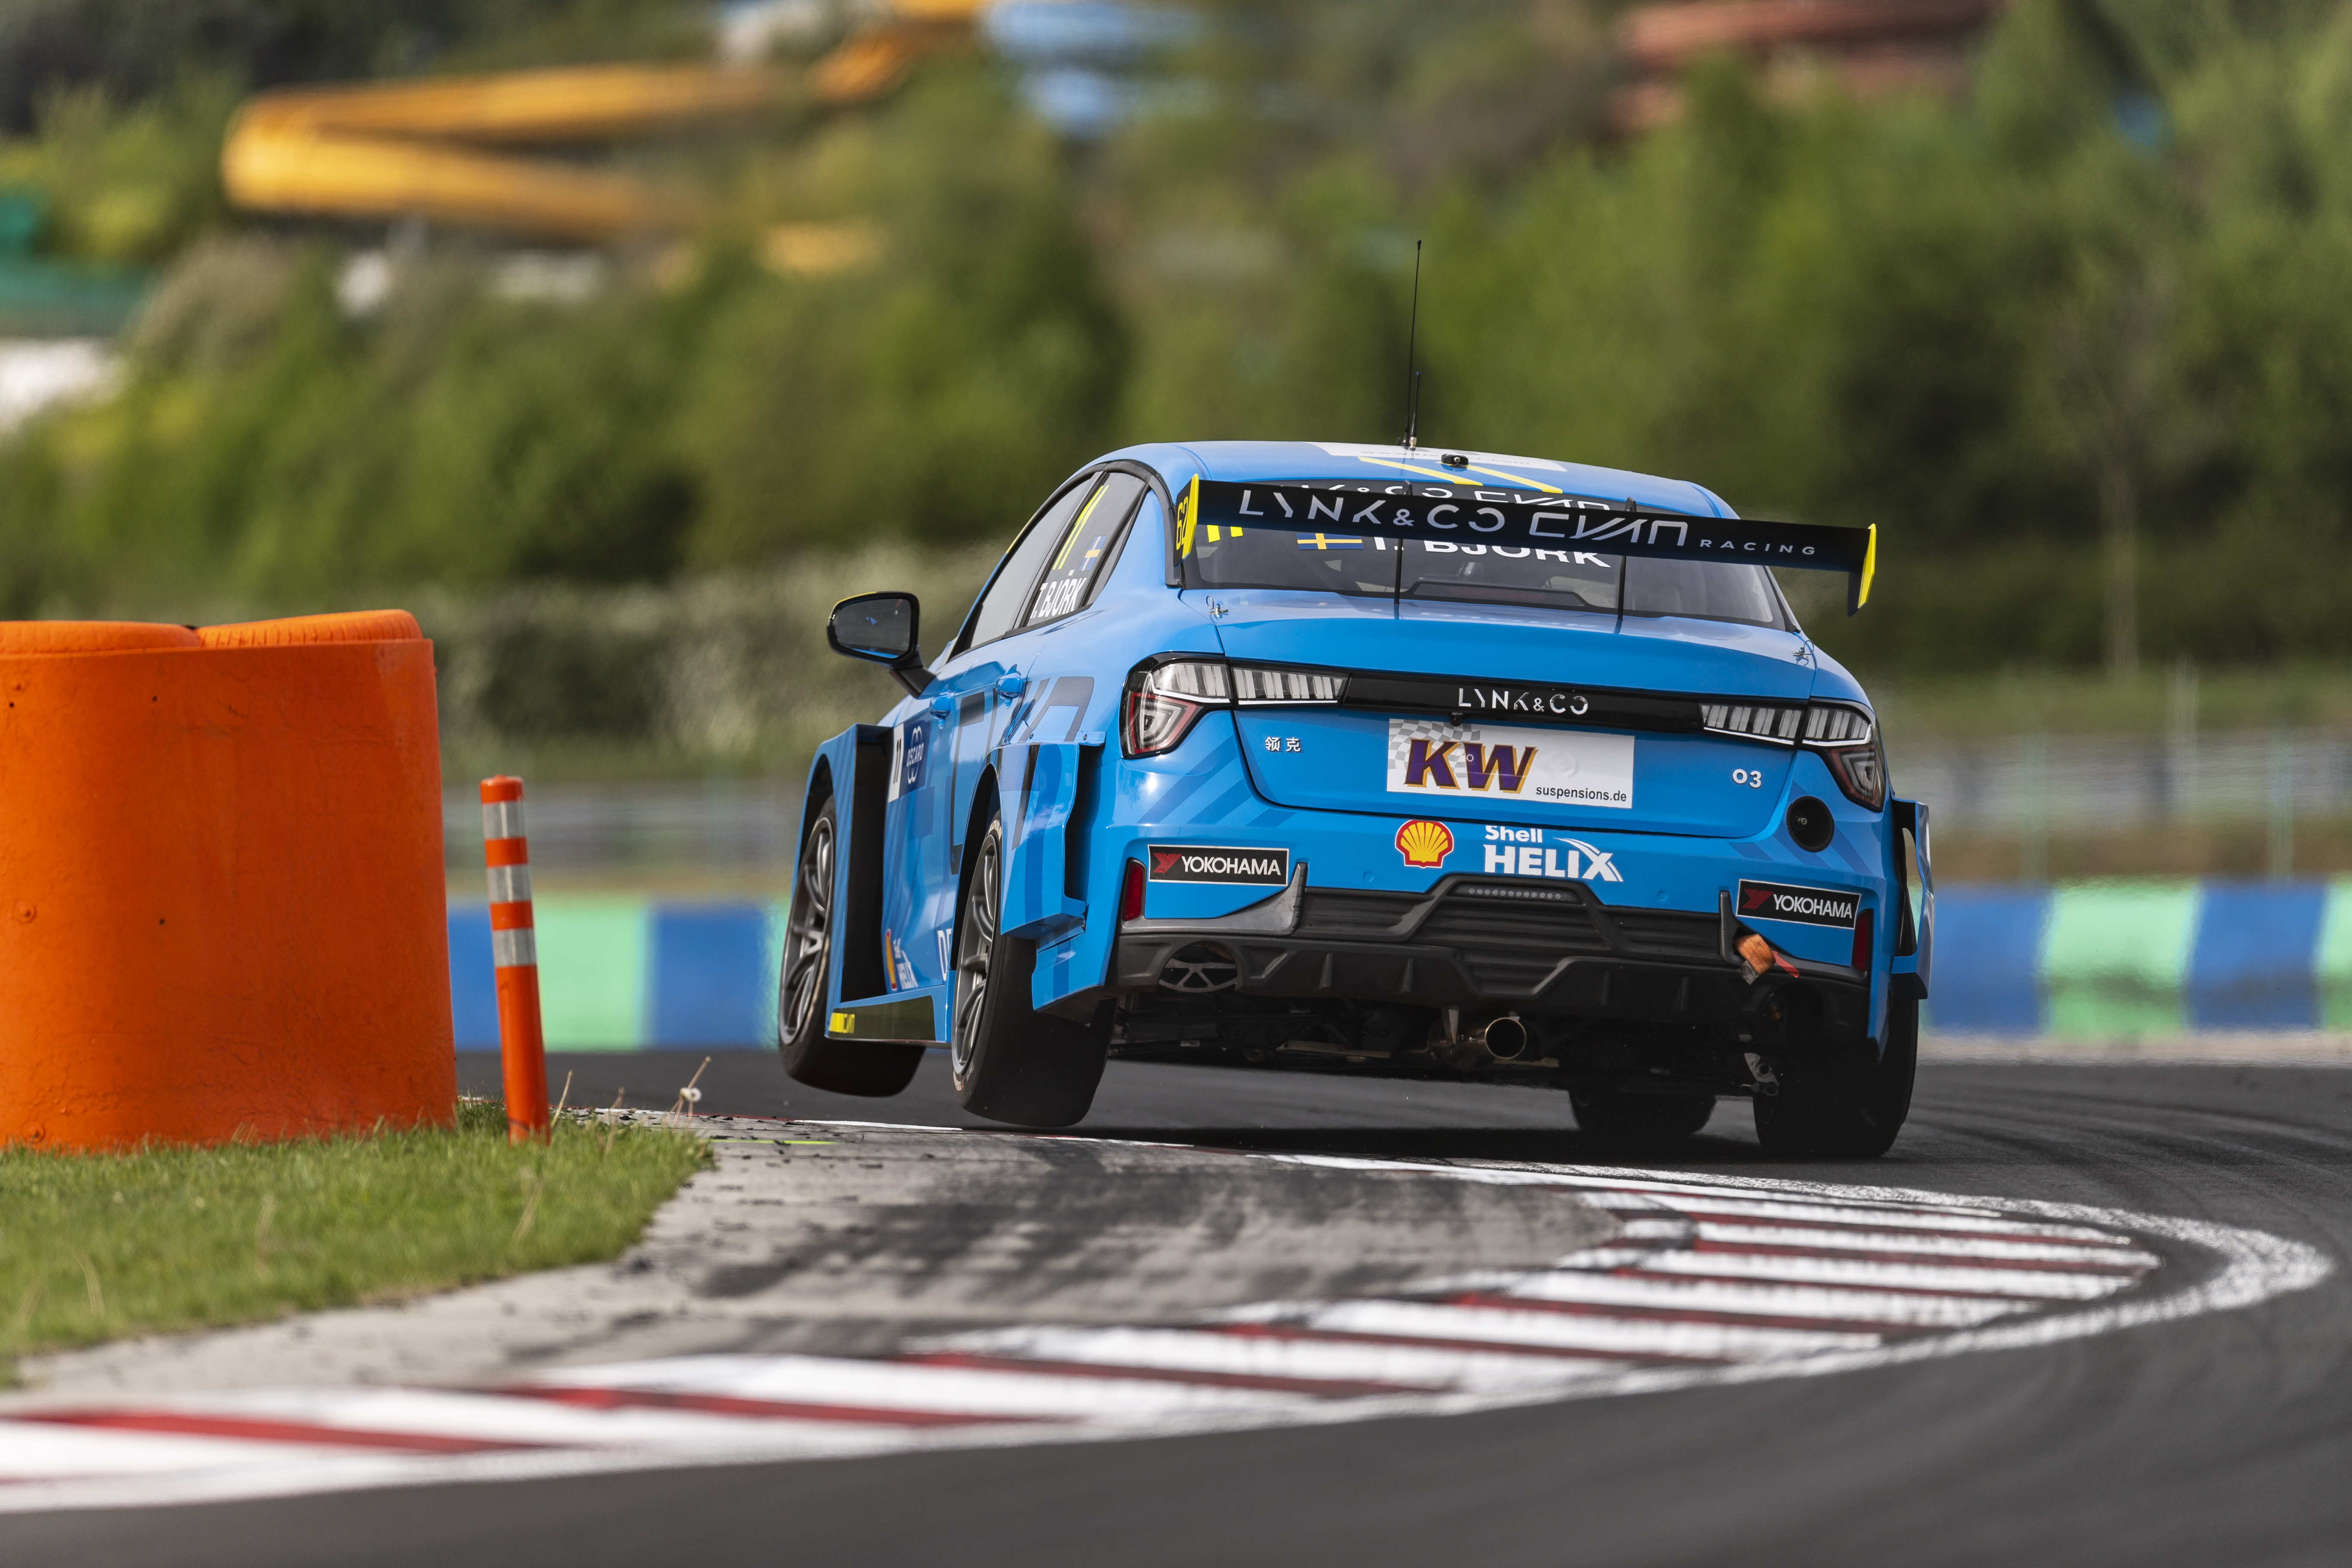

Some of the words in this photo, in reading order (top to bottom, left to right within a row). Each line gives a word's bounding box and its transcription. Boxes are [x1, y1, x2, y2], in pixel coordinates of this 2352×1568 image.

[1176, 496, 1188, 551] 62
[1700, 539, 1815, 556] RACING
[1038, 569, 1087, 618] BJÖRK
[1265, 736, 1301, 752] 领克
[1403, 738, 1539, 794] KW
[1536, 786, 1627, 802] suspensions.de
[1485, 825, 1543, 843] Shell
[1181, 856, 1281, 876] YOKOHAMA
[1483, 837, 1624, 882] HELIX
[1773, 893, 1853, 919] YOKOHAMA
